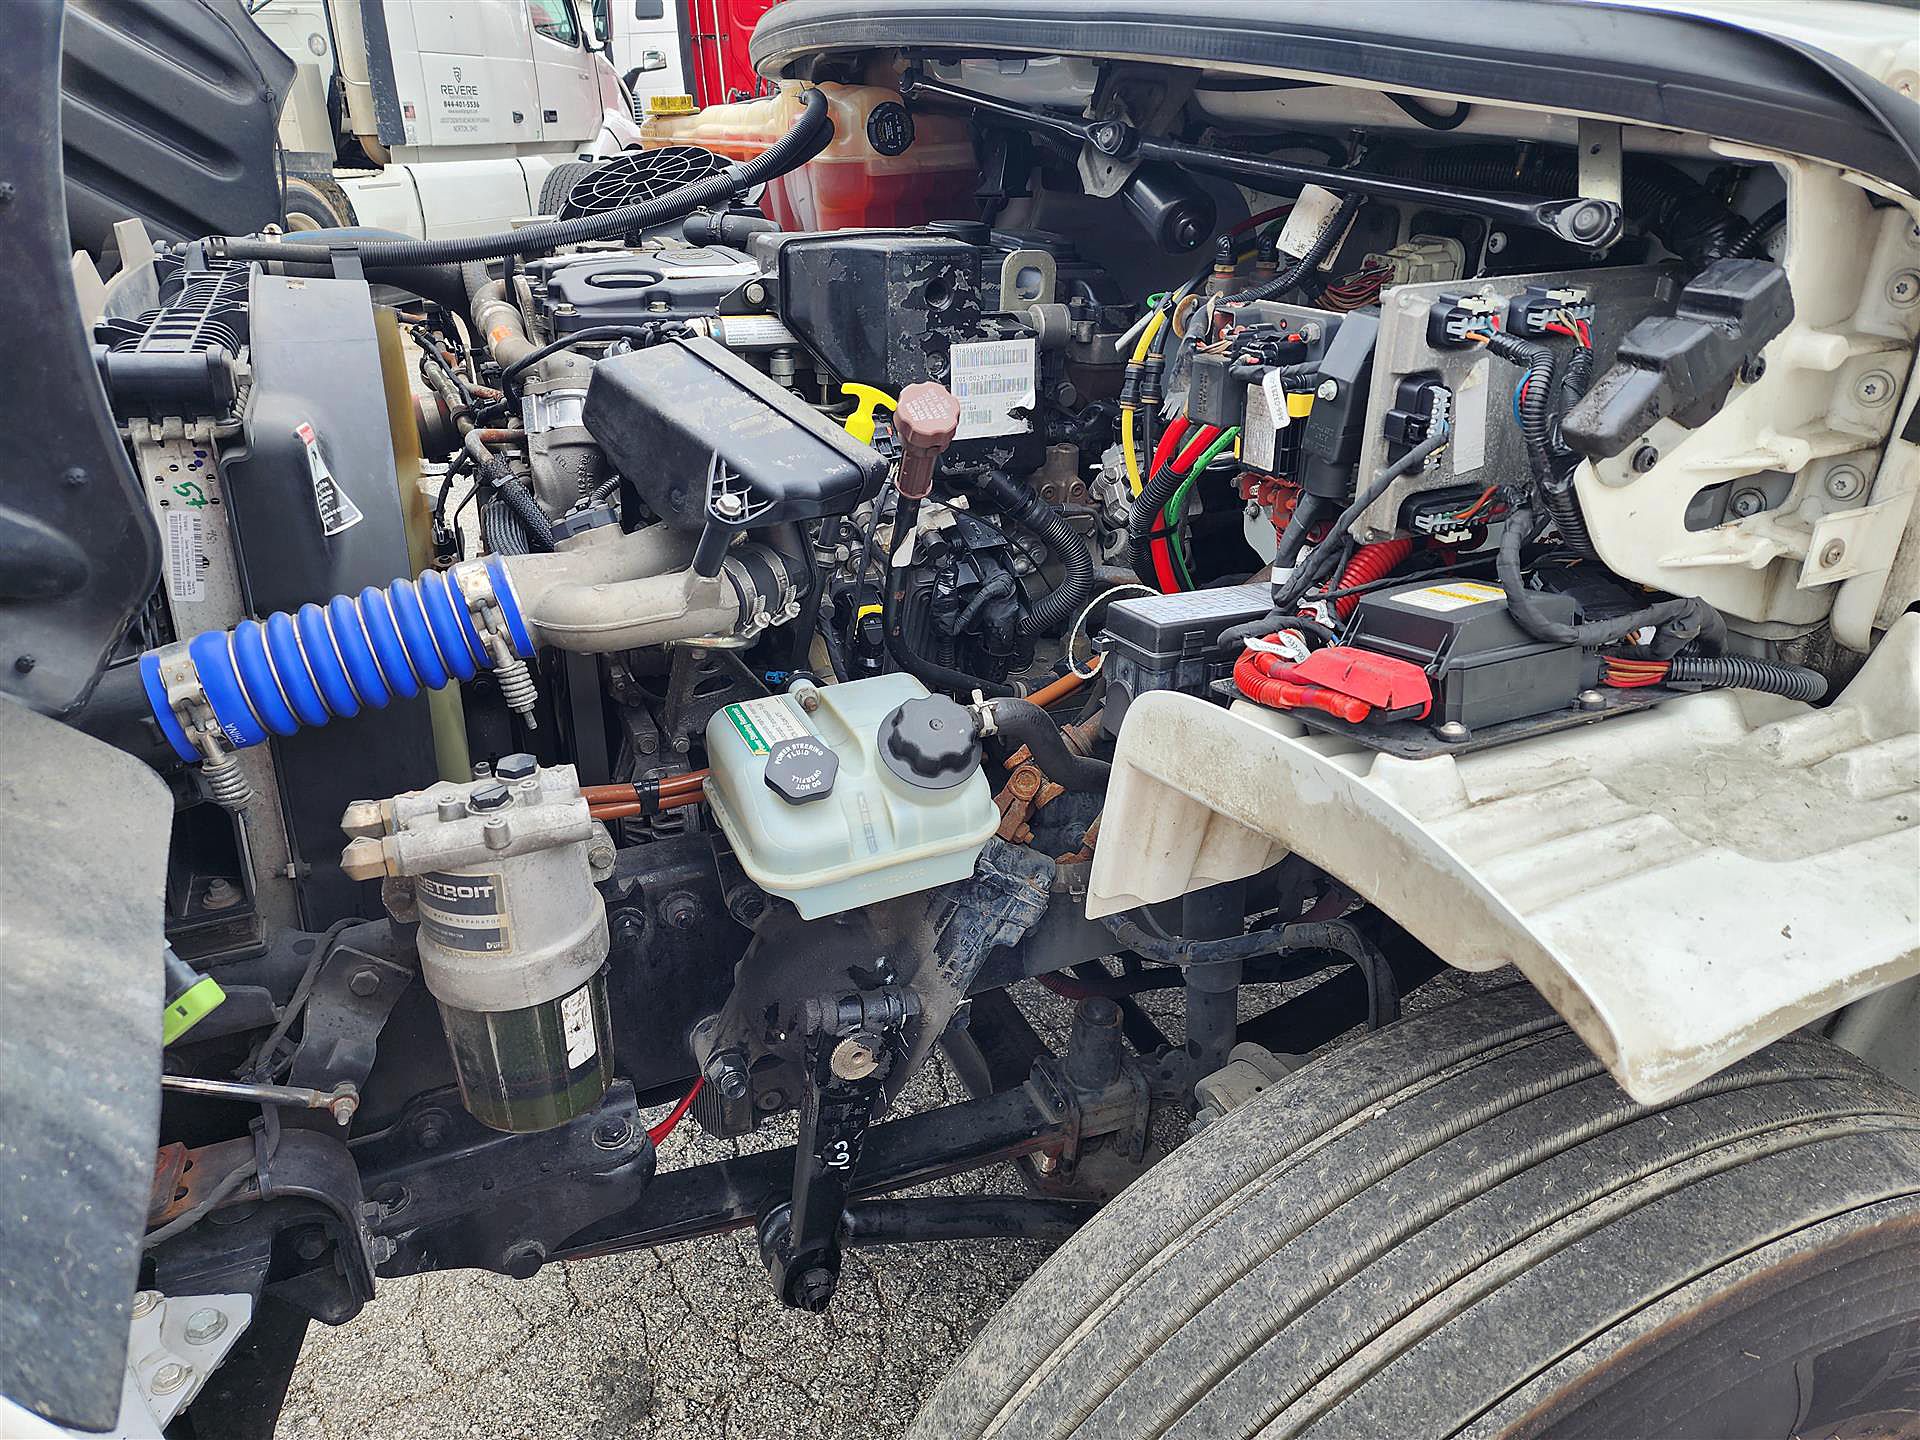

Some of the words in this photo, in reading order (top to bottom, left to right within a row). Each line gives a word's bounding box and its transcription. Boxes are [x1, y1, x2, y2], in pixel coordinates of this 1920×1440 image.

[440, 84, 479, 95] REVERE
[225, 722, 247, 744] CHINA
[774, 746, 792, 765] POWER
[792, 743, 824, 757] STEERING
[786, 750, 810, 760] FLUID
[791, 769, 822, 784] OVERFILL
[812, 780, 822, 788] DO
